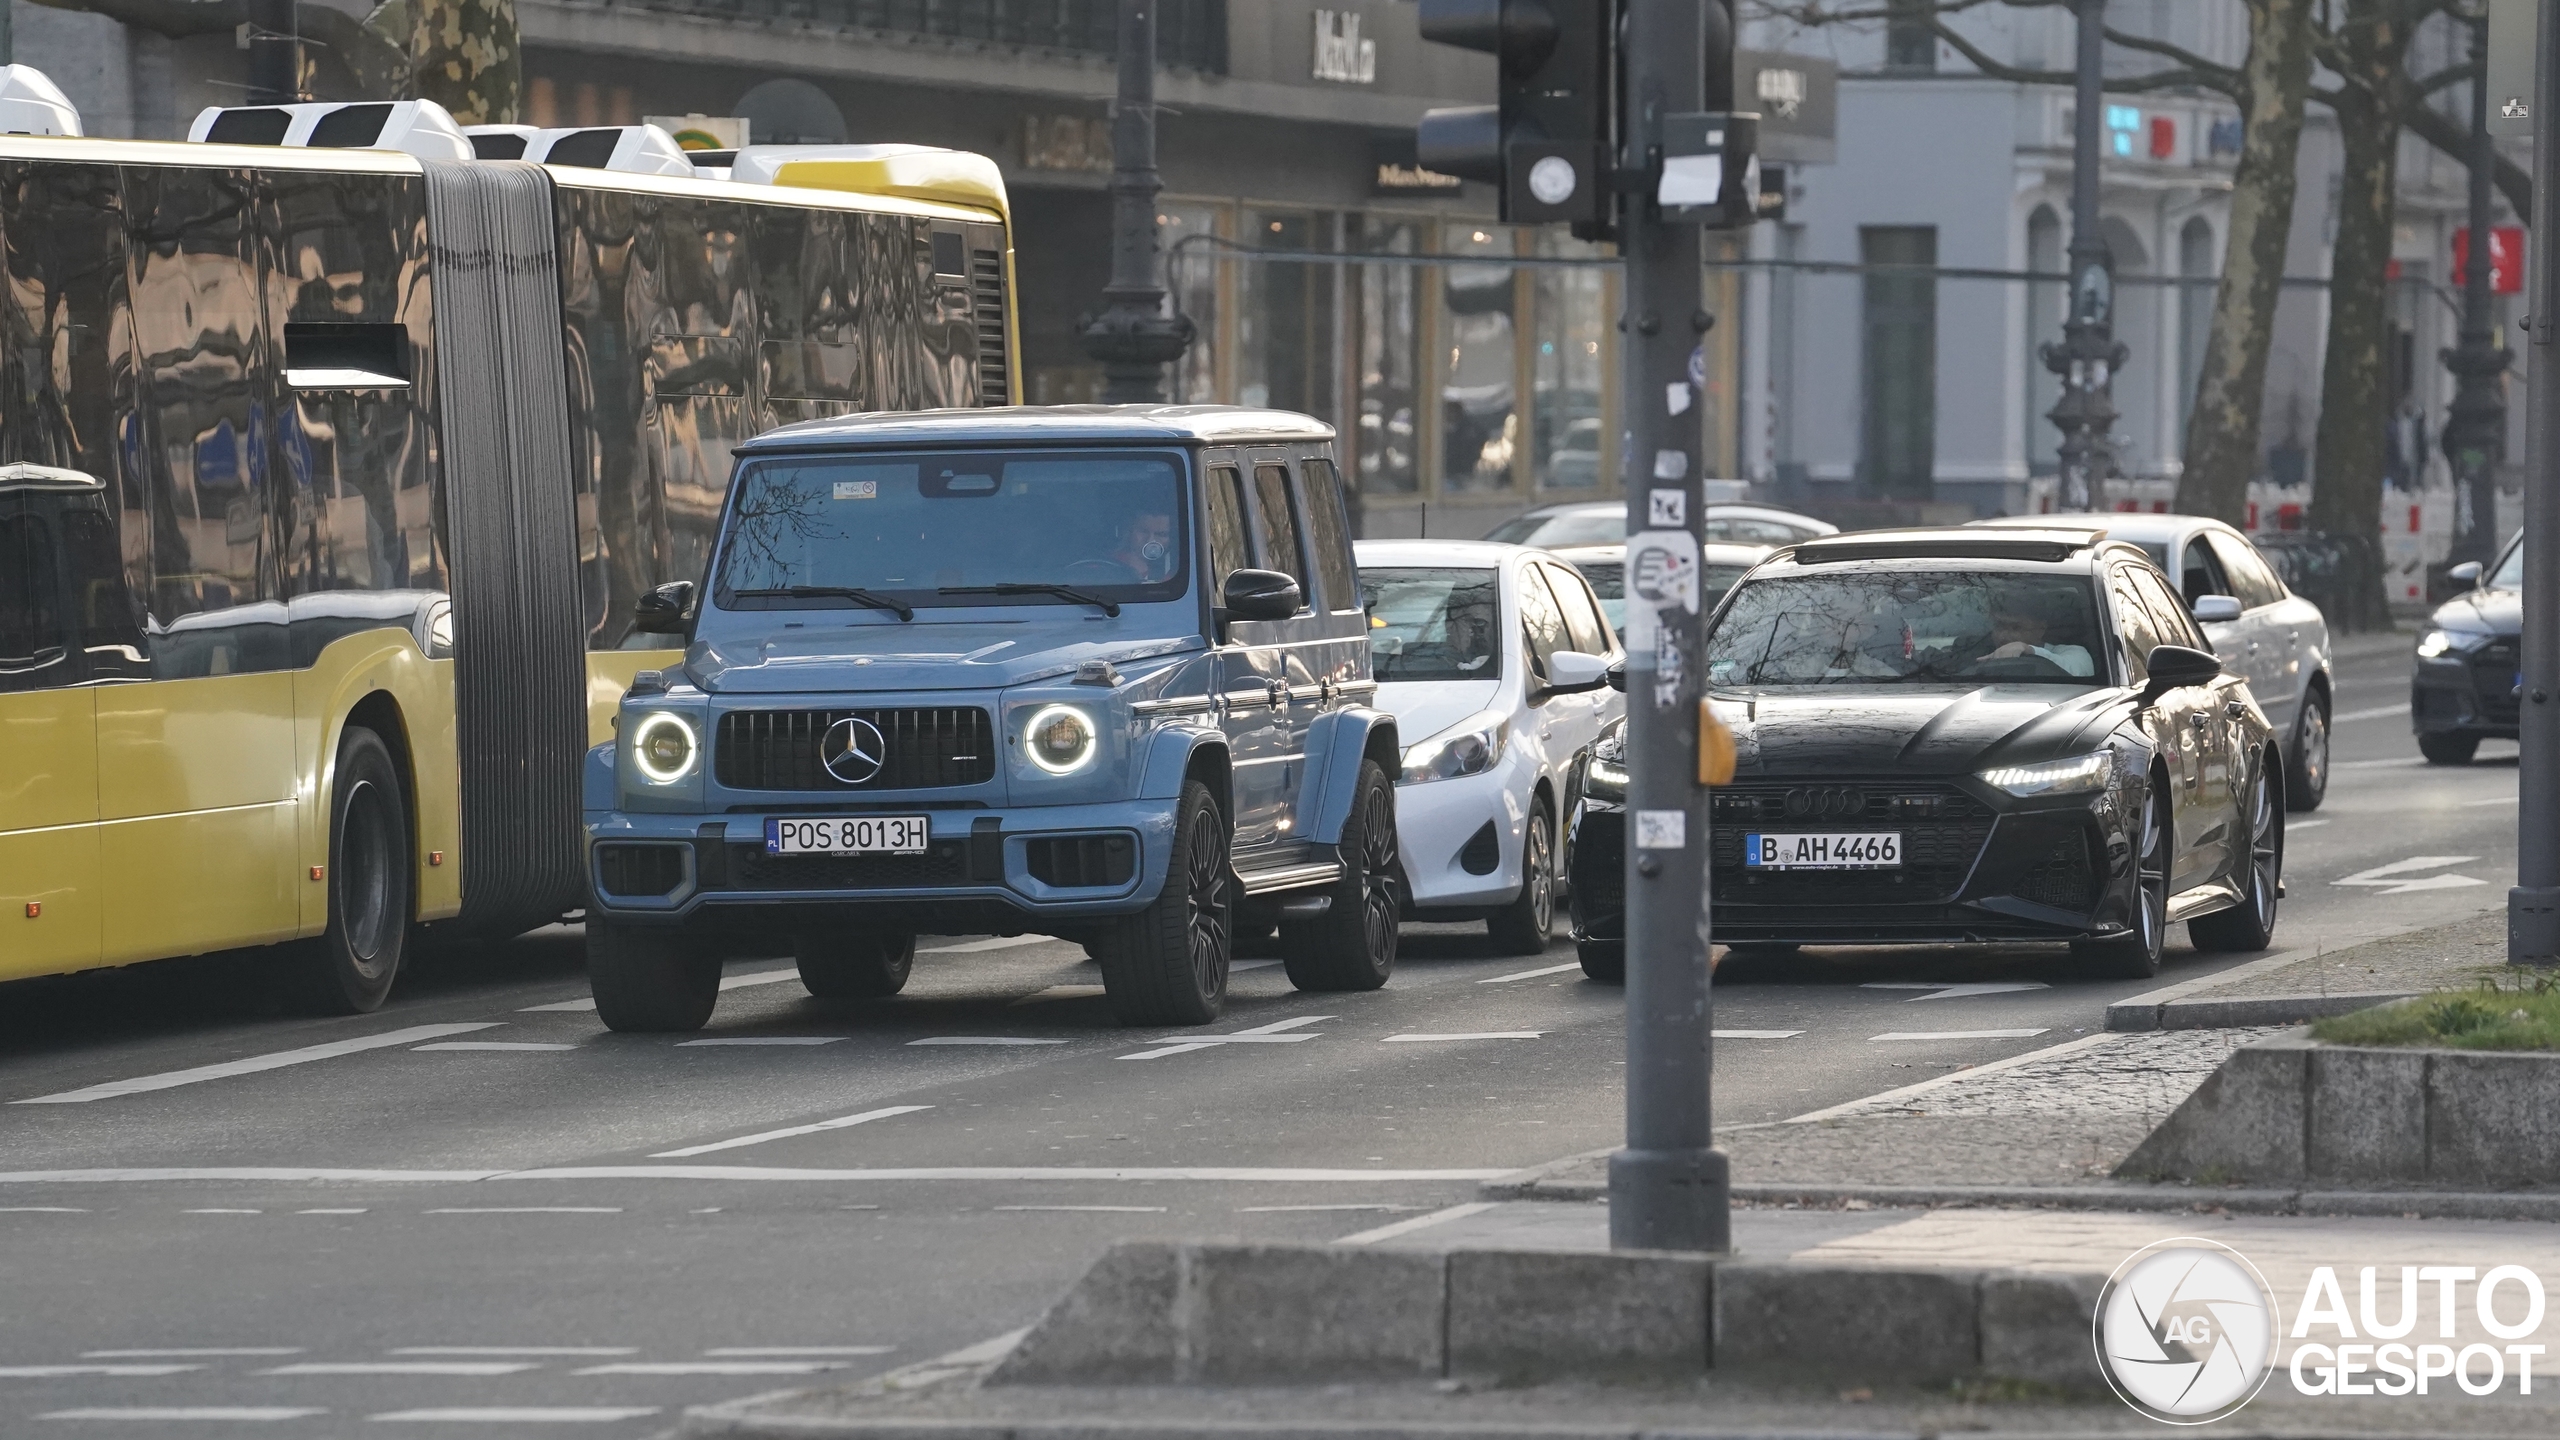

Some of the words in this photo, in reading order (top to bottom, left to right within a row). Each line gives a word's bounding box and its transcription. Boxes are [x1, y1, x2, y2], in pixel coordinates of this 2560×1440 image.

[781, 822, 832, 849] POS
[841, 820, 924, 848] 8013H
[1762, 838, 1778, 862] B
[1796, 838, 1828, 862] AH
[1833, 837, 1896, 861] 4466
